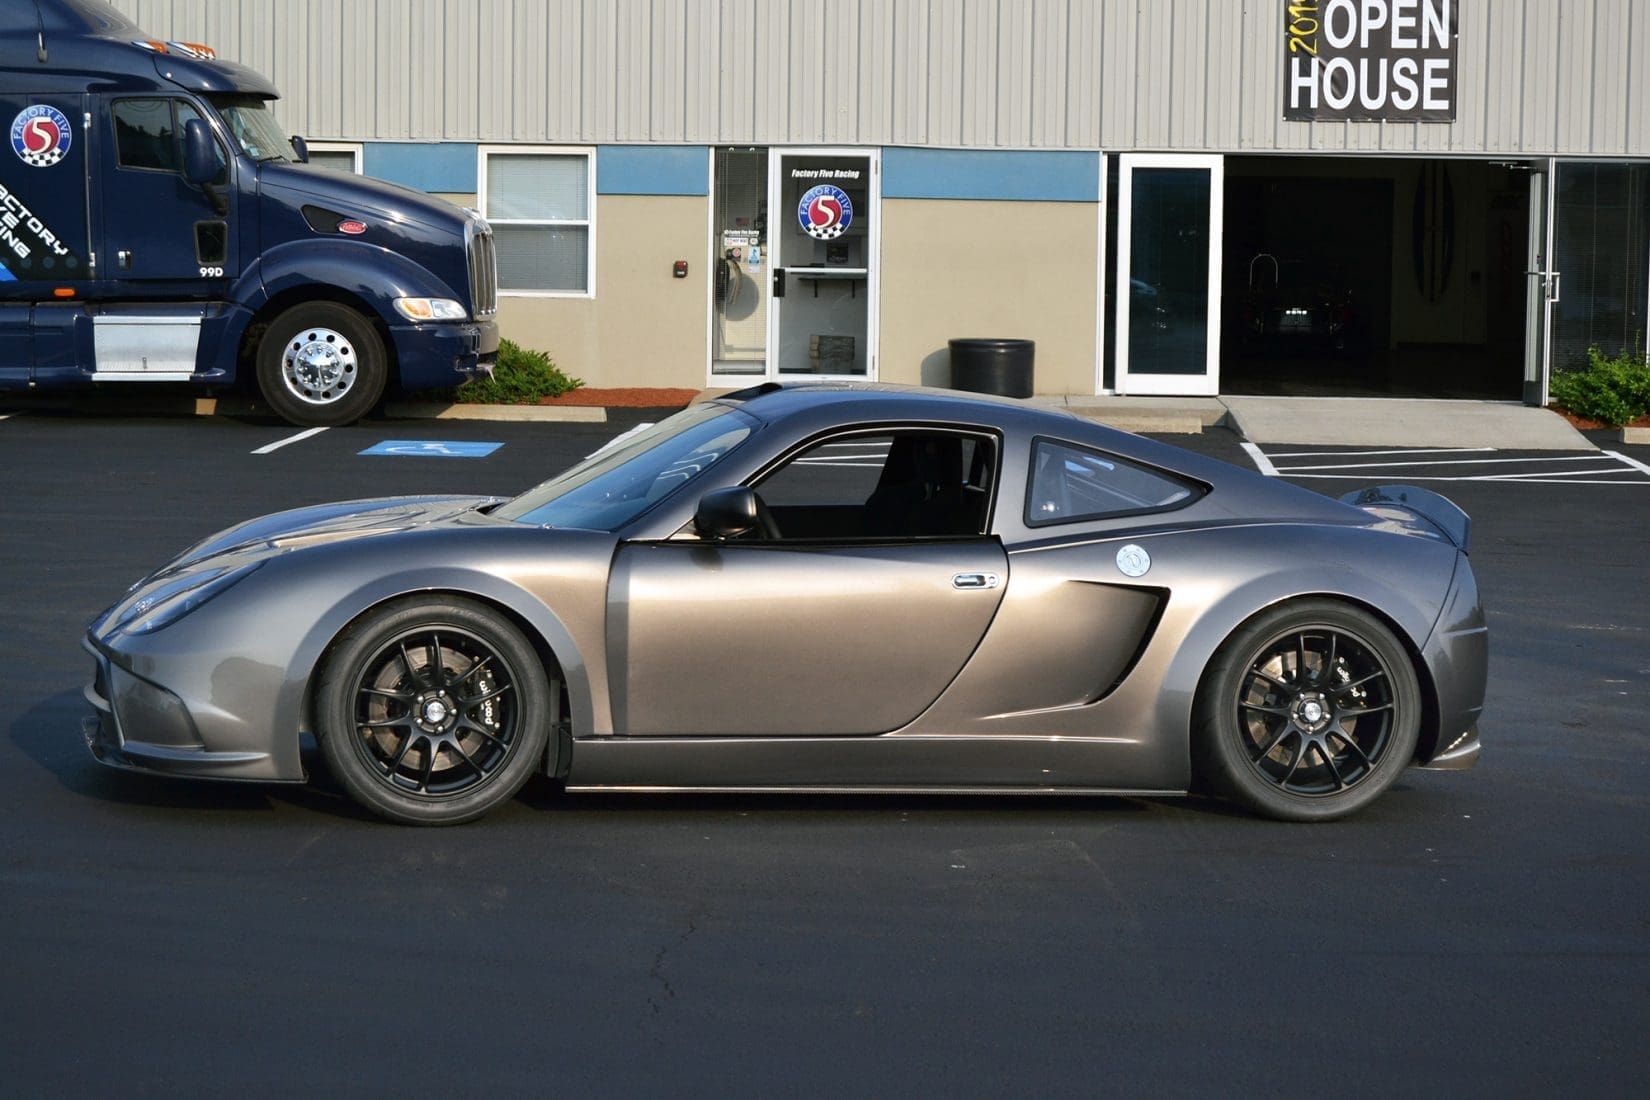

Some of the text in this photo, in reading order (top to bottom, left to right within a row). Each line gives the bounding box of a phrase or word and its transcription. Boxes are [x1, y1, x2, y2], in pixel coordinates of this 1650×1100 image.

[1288, 0, 1319, 54] 201
[1324, 0, 1450, 49] OPEN
[1290, 57, 1450, 110] HOUSE
[13, 107, 70, 140] FACTORY FIVE
[31, 116, 52, 155] 5
[791, 168, 860, 179] Factory Five Racing
[800, 186, 851, 215] FACTORY FIVE
[816, 195, 835, 229] 5
[0, 184, 69, 255] ACTORY
[200, 267, 224, 277] 99D
